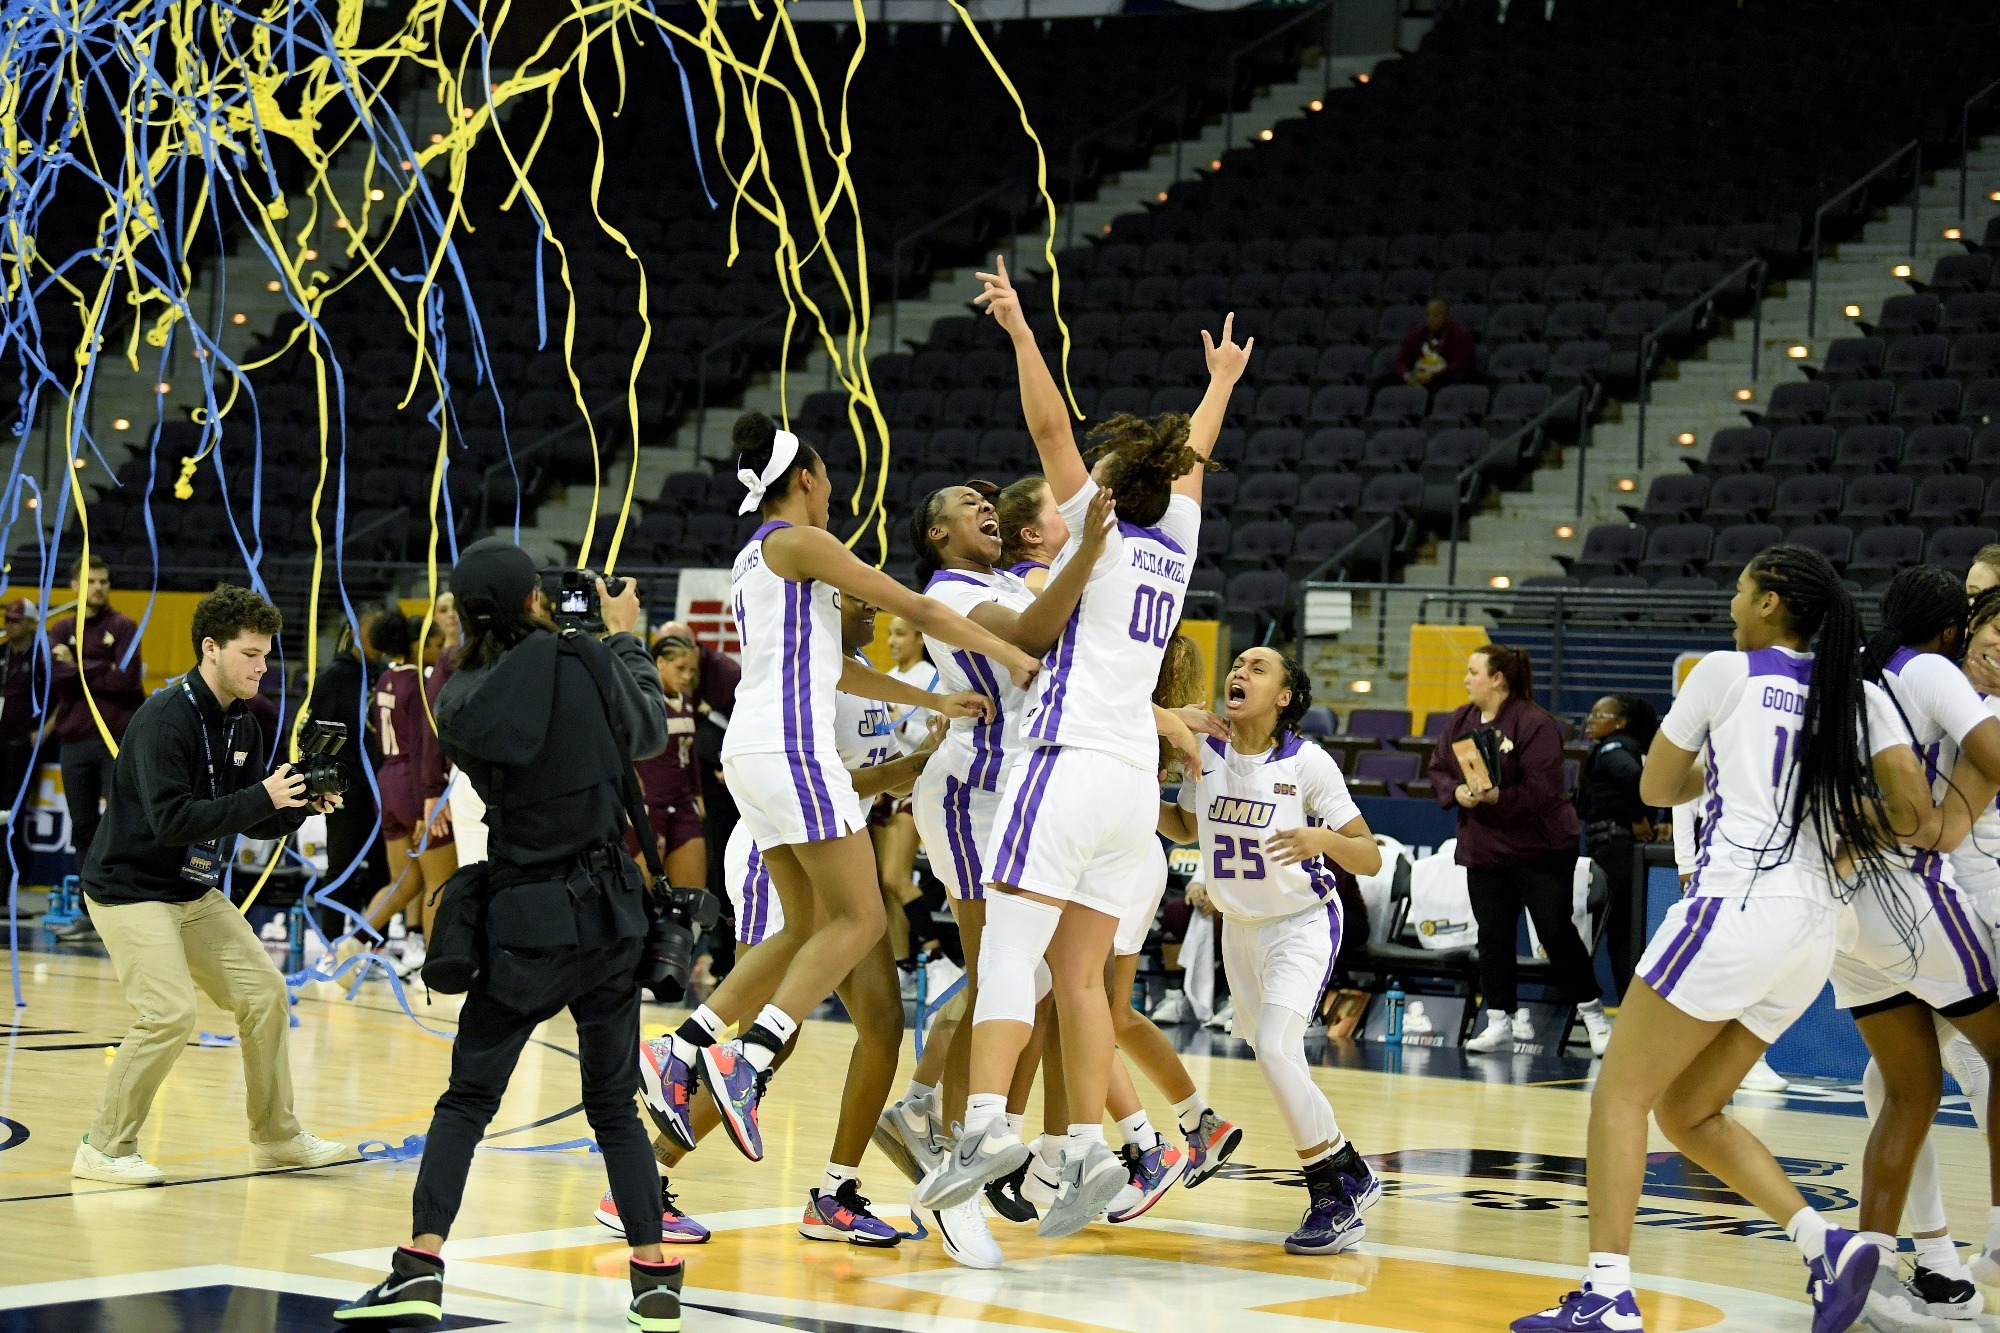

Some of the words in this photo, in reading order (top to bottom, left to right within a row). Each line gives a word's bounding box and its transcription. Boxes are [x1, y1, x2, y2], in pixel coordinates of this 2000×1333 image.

[735, 588, 747, 647] 4
[1129, 584, 1175, 648] 00
[1763, 686, 1805, 715] GOOD
[1208, 795, 1276, 829] JMU
[1213, 834, 1266, 879] 25
